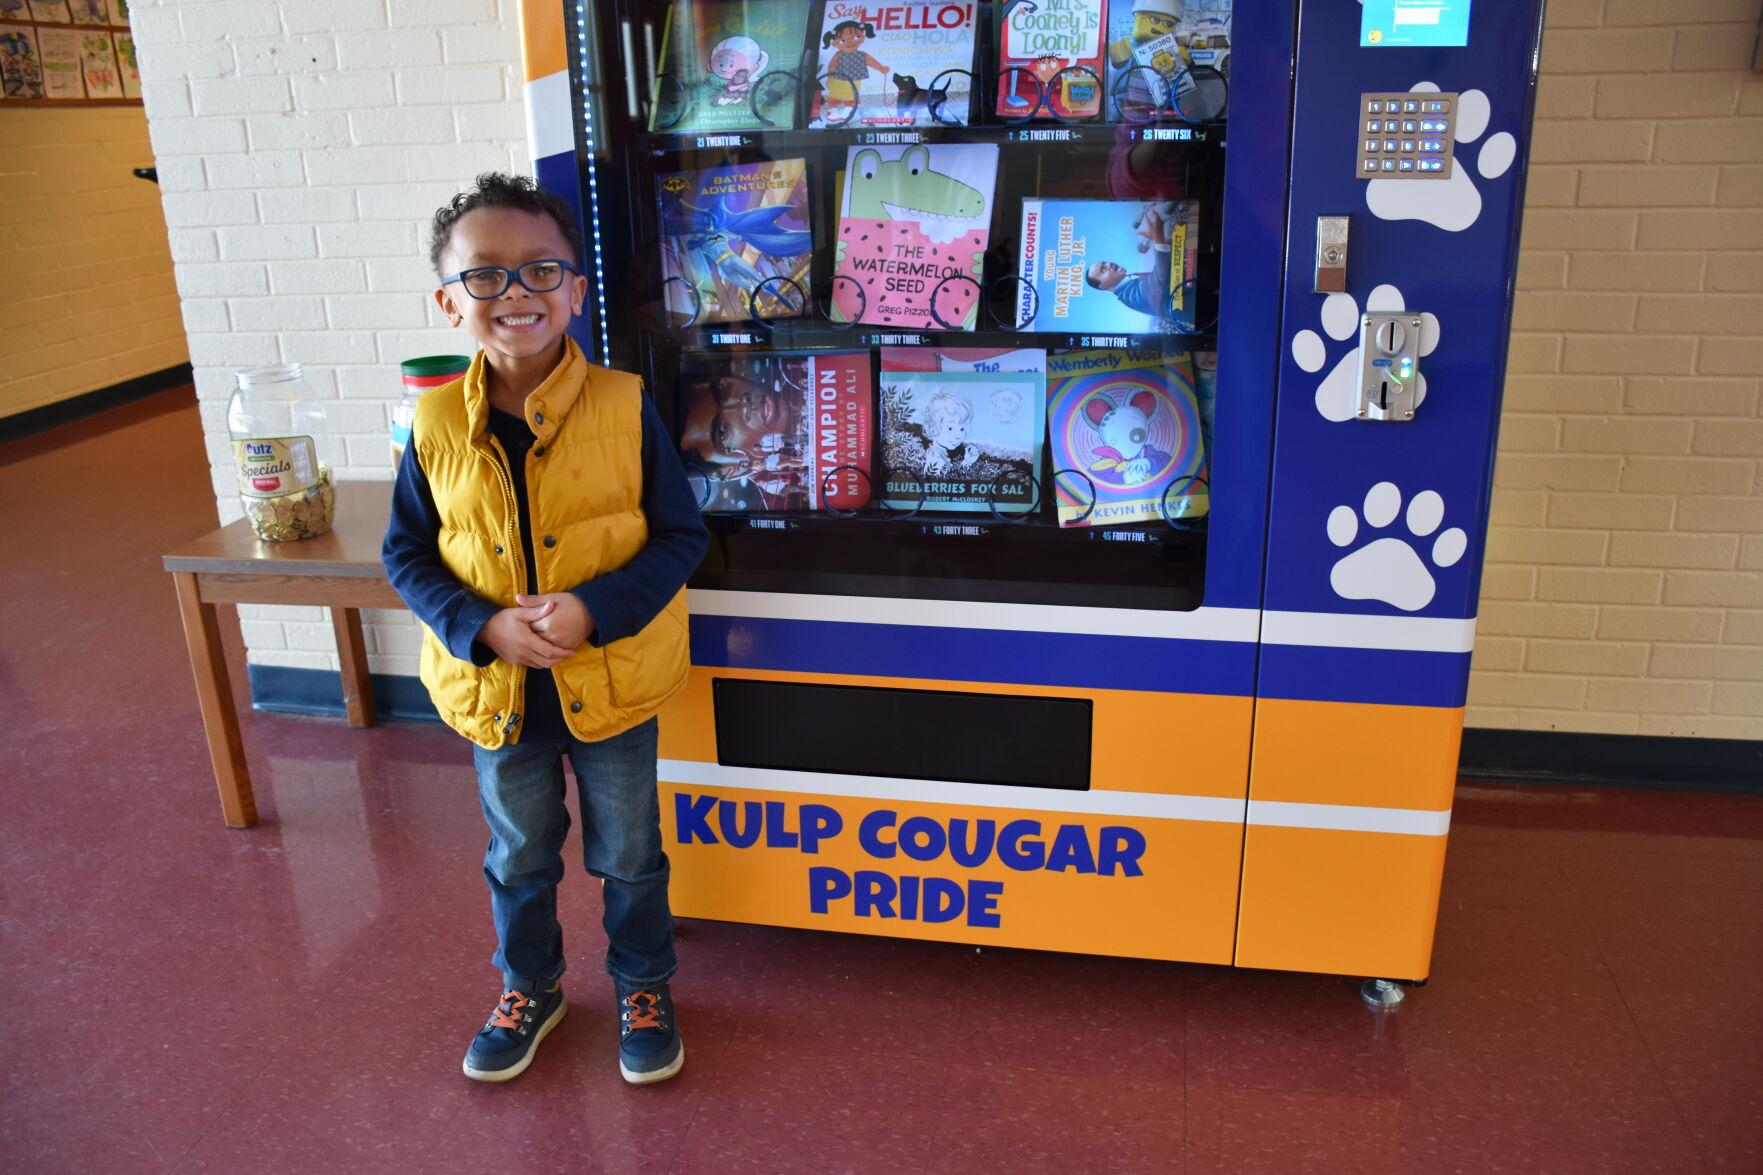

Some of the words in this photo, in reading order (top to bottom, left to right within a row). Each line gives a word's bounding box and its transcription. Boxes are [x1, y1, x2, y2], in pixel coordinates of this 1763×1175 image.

[828, 4, 864, 20] Say
[861, 4, 972, 30] HELLO!
[1083, 10, 1098, 29] Is
[881, 32, 912, 42] CIAO
[913, 29, 969, 45] HOLA
[1021, 31, 1088, 55] Loony!
[697, 137, 705, 147] 21
[706, 136, 729, 147] TWENTY
[729, 135, 741, 146] ONE
[866, 133, 875, 143] 23
[876, 133, 900, 143] TWENTY
[900, 133, 919, 143] THREE
[1019, 130, 1029, 141] 25
[1030, 130, 1055, 141] TWENTY
[1055, 130, 1070, 140] FIVE
[1143, 130, 1153, 140] 26
[1154, 130, 1179, 140] TWENTY
[1179, 129, 1191, 140] SIX
[701, 177, 796, 195] ADVENTURES
[1060, 216, 1073, 263] LUTHER
[1073, 237, 1086, 256] JR.
[894, 244, 925, 259] THE
[1174, 234, 1183, 266] RESPECT
[852, 257, 963, 280] WATERMELON
[1045, 250, 1056, 281] YOUNG
[885, 277, 925, 294] SEED
[1070, 260, 1086, 297] KING,
[1056, 266, 1069, 317] MARTIN
[877, 305, 902, 315] GREG
[904, 307, 935, 317] PIZZO
[712, 334, 719, 344] 31
[720, 334, 740, 344] THIRTY
[740, 334, 751, 344] ONE
[871, 334, 880, 344] 33
[881, 334, 901, 344] THIRTY
[902, 334, 920, 344] THREE
[1081, 336, 1090, 347] 35
[1091, 336, 1113, 347] THIRTY
[1113, 336, 1127, 347] FIVE
[974, 362, 1000, 373] The
[1049, 353, 1122, 373] Wemberly
[846, 368, 857, 394] ALI
[820, 369, 838, 497] CHAMPION
[846, 402, 859, 496] MUHAMMAD
[241, 460, 292, 479] Specials
[886, 481, 966, 494] BLUEBERRIES
[971, 483, 996, 494] FOR
[1002, 484, 1024, 495] SAL
[1094, 505, 1136, 519] KEVIN
[757, 520, 774, 529] FORTY
[774, 520, 785, 529] ONE
[933, 527, 942, 535] 43
[943, 526, 961, 536] FORTY
[962, 526, 980, 536] THREE
[1102, 531, 1112, 540] 45
[1112, 531, 1132, 541] FORTY
[1132, 532, 1145, 542] FIVE
[674, 793, 843, 854] KULP
[858, 809, 1146, 877] COUGAR
[808, 866, 1004, 929] PRIDE
